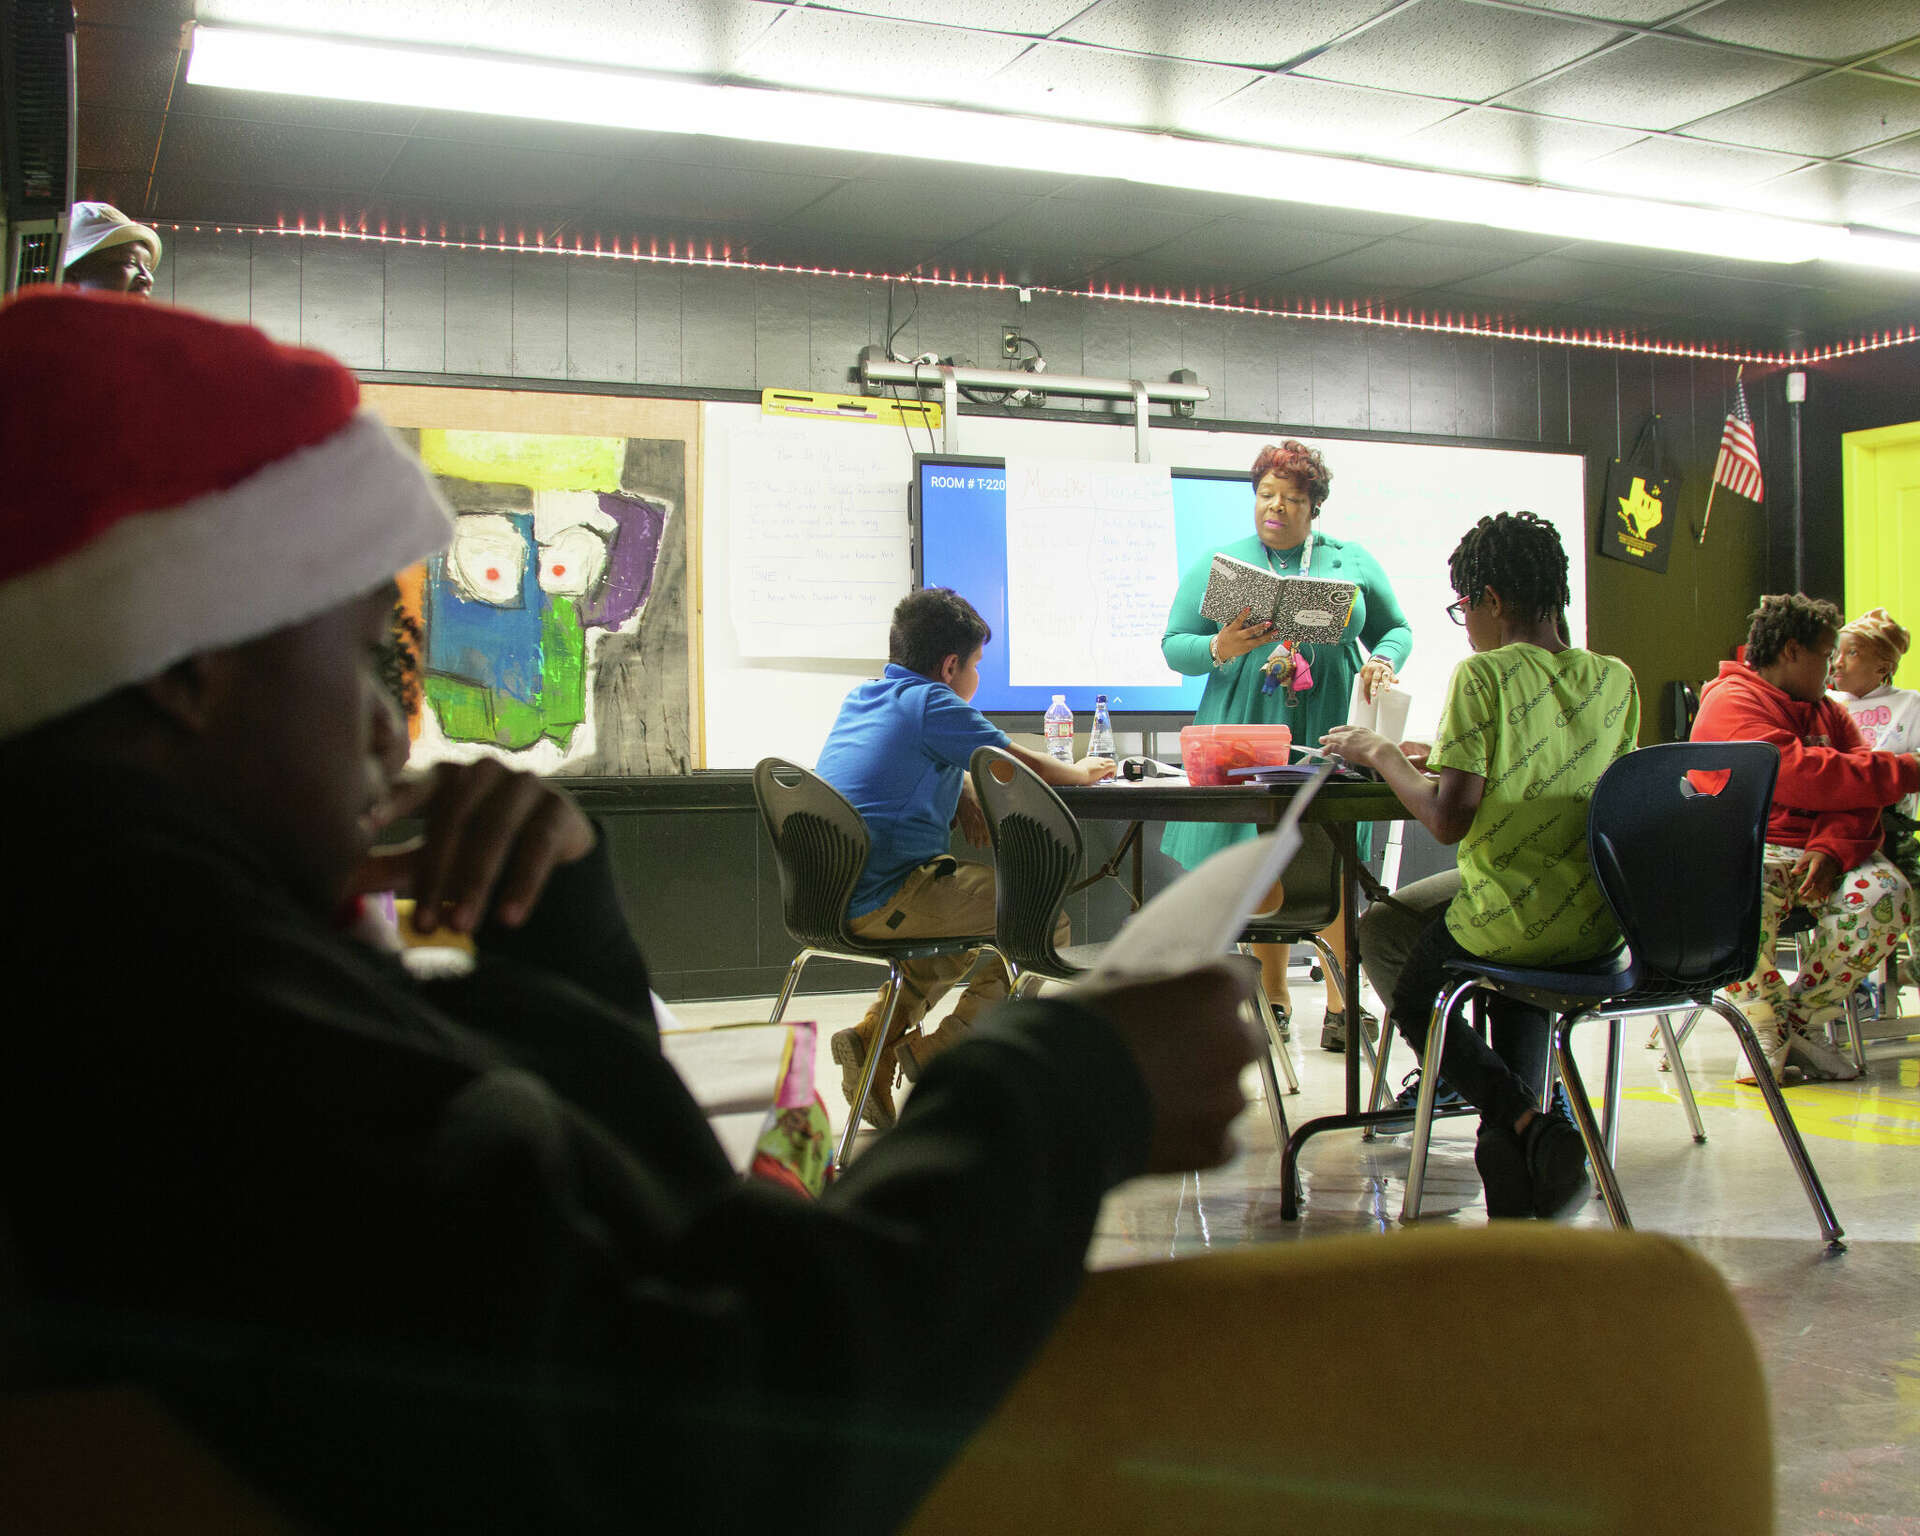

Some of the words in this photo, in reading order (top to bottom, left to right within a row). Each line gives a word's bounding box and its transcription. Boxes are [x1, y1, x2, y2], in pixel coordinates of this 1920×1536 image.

[931, 476, 965, 489] ROOM
[967, 478, 975, 489] #
[977, 478, 1005, 490] T-220
[1524, 738, 1598, 801] Champion
[1493, 812, 1562, 873] Champion
